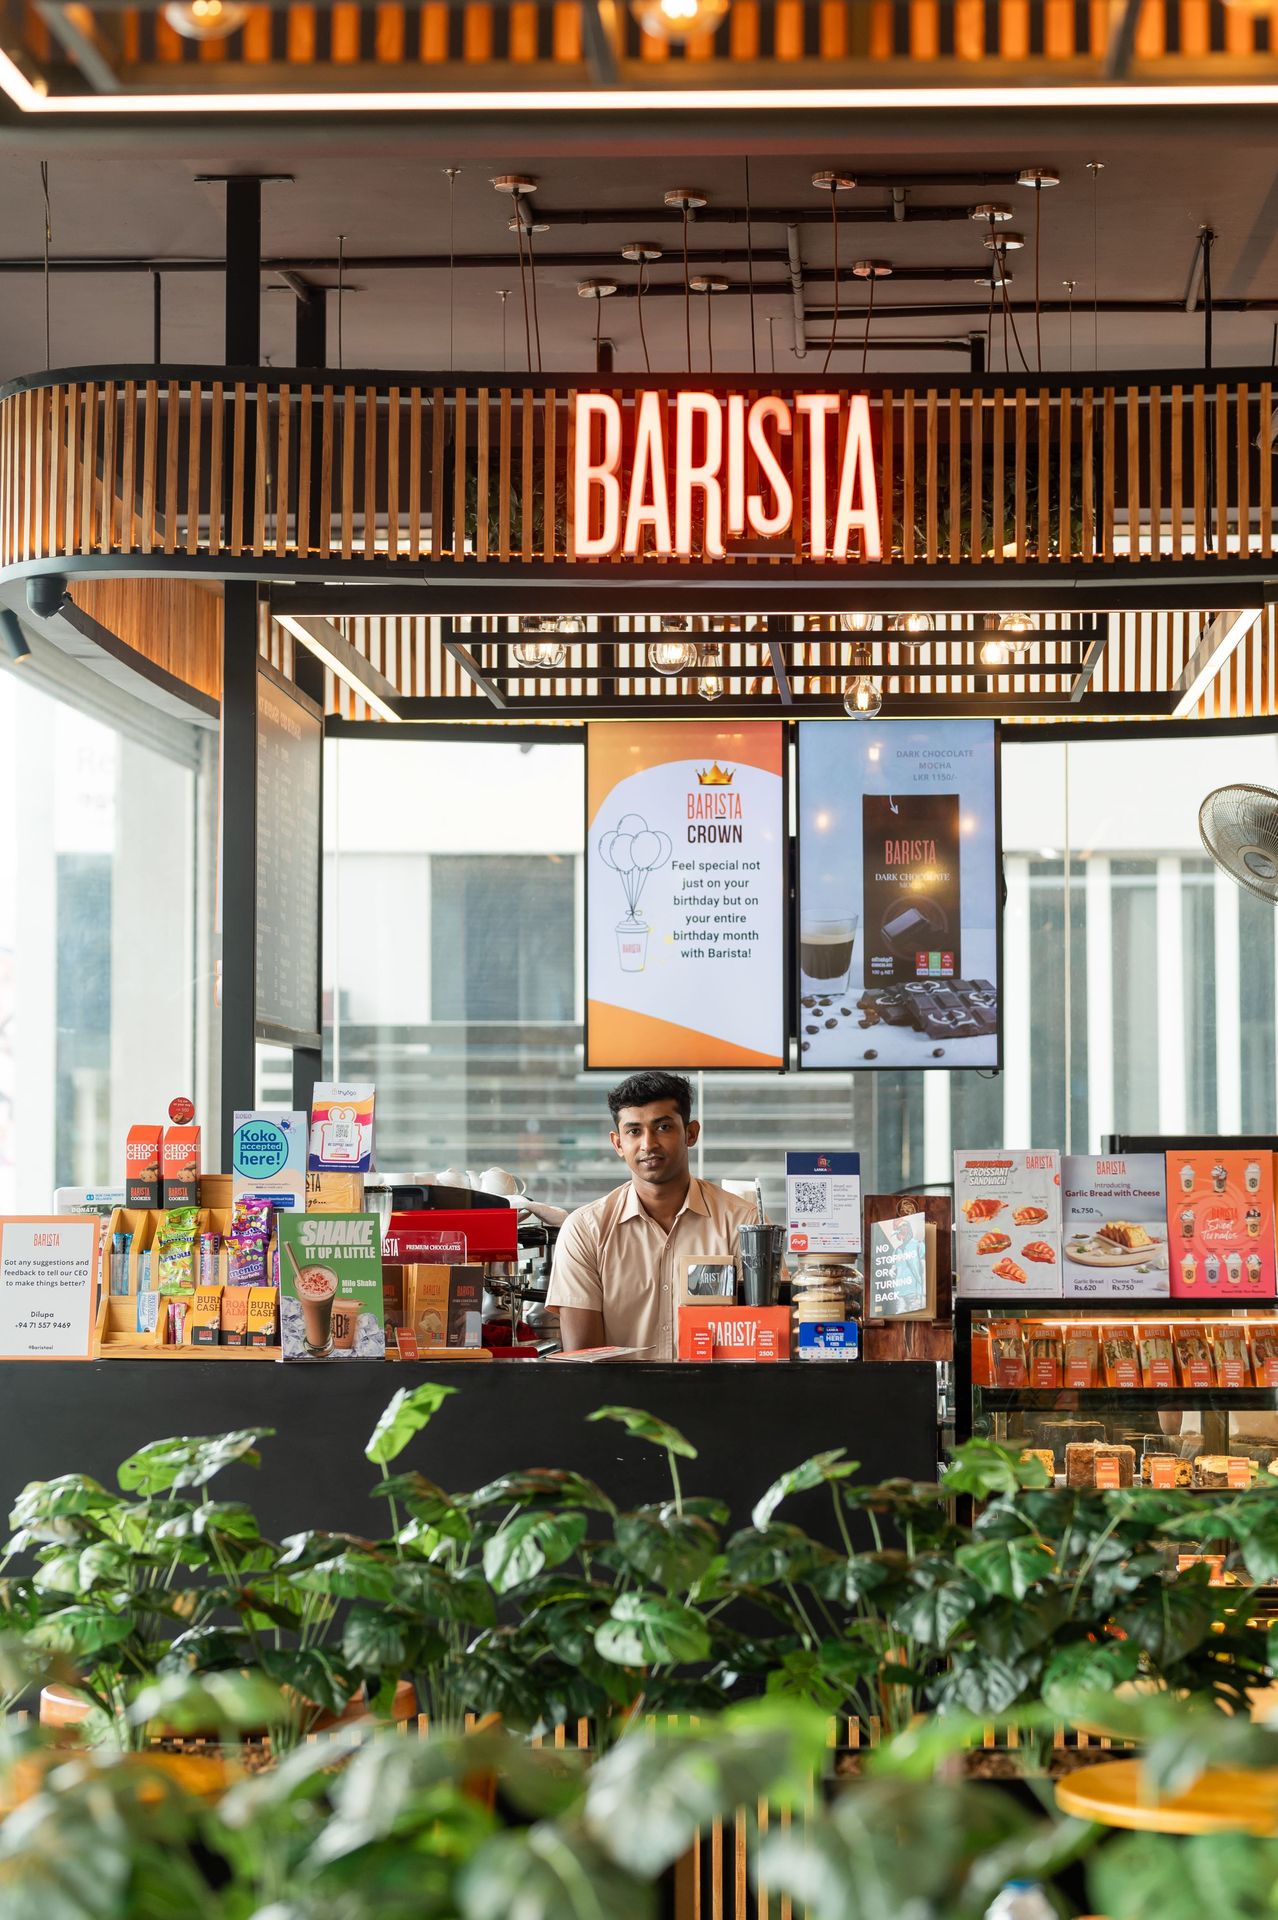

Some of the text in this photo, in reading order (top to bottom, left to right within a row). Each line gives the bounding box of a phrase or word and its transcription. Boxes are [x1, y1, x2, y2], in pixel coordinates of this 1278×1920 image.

[574, 391, 881, 561] BARISTA
[896, 750, 975, 758] DARK CHOCOLATE
[919, 762, 952, 770] MOCHA
[913, 774, 929, 782] LKR
[687, 793, 742, 819] BARISTA
[687, 825, 742, 843] CROWN
[885, 840, 937, 865] BARISTA
[671, 860, 761, 873] Feel special not
[875, 873, 898, 881] DARK
[682, 878, 749, 890] just on your
[673, 895, 759, 908] birthday but on
[686, 913, 747, 926] your entire
[673, 930, 759, 943] birthday month
[681, 948, 752, 958] with Barista!
[241, 1130, 277, 1141] Koko
[241, 1143, 282, 1151] accepted
[127, 1152, 151, 1160] CHIP
[164, 1152, 189, 1160] CHIP
[240, 1152, 280, 1165] here!
[1026, 1155, 1053, 1169] BARISTA
[969, 1168, 1009, 1177] CROISSANT
[1096, 1161, 1126, 1175] BARISTA
[969, 1176, 1007, 1186] SANDWICH
[1211, 1208, 1238, 1220] BARISTA
[300, 1220, 374, 1246] SHAKE
[33, 1234, 60, 1246] BARISTA
[306, 1247, 376, 1259] IT UP A LITTLE
[875, 1244, 889, 1254] NO
[33, 1259, 74, 1267] suggestions
[875, 1269, 889, 1278] OR
[36, 1280, 58, 1288] things
[875, 1277, 912, 1290] TURNING
[875, 1292, 900, 1303] BACK
[30, 1311, 54, 1320] Dilupa
